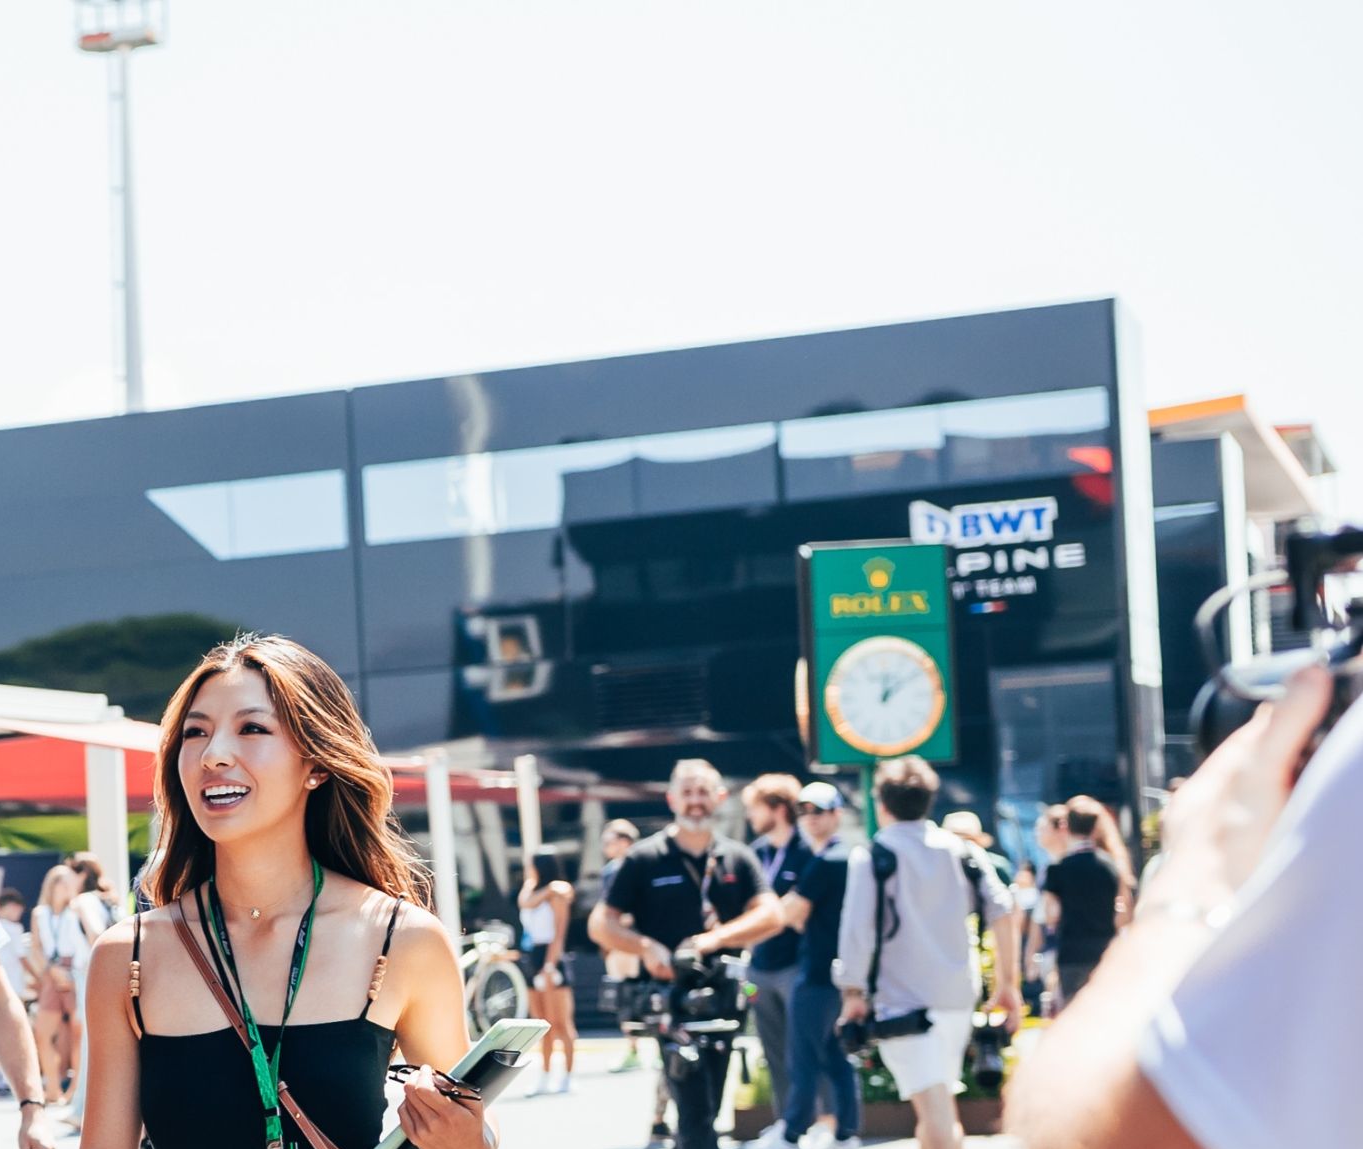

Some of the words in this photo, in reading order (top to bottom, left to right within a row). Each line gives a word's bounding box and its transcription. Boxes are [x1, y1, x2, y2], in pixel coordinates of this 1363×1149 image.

[959, 505, 1050, 540] BWT
[956, 543, 1086, 577] PINE
[830, 591, 930, 618] ROLEX
